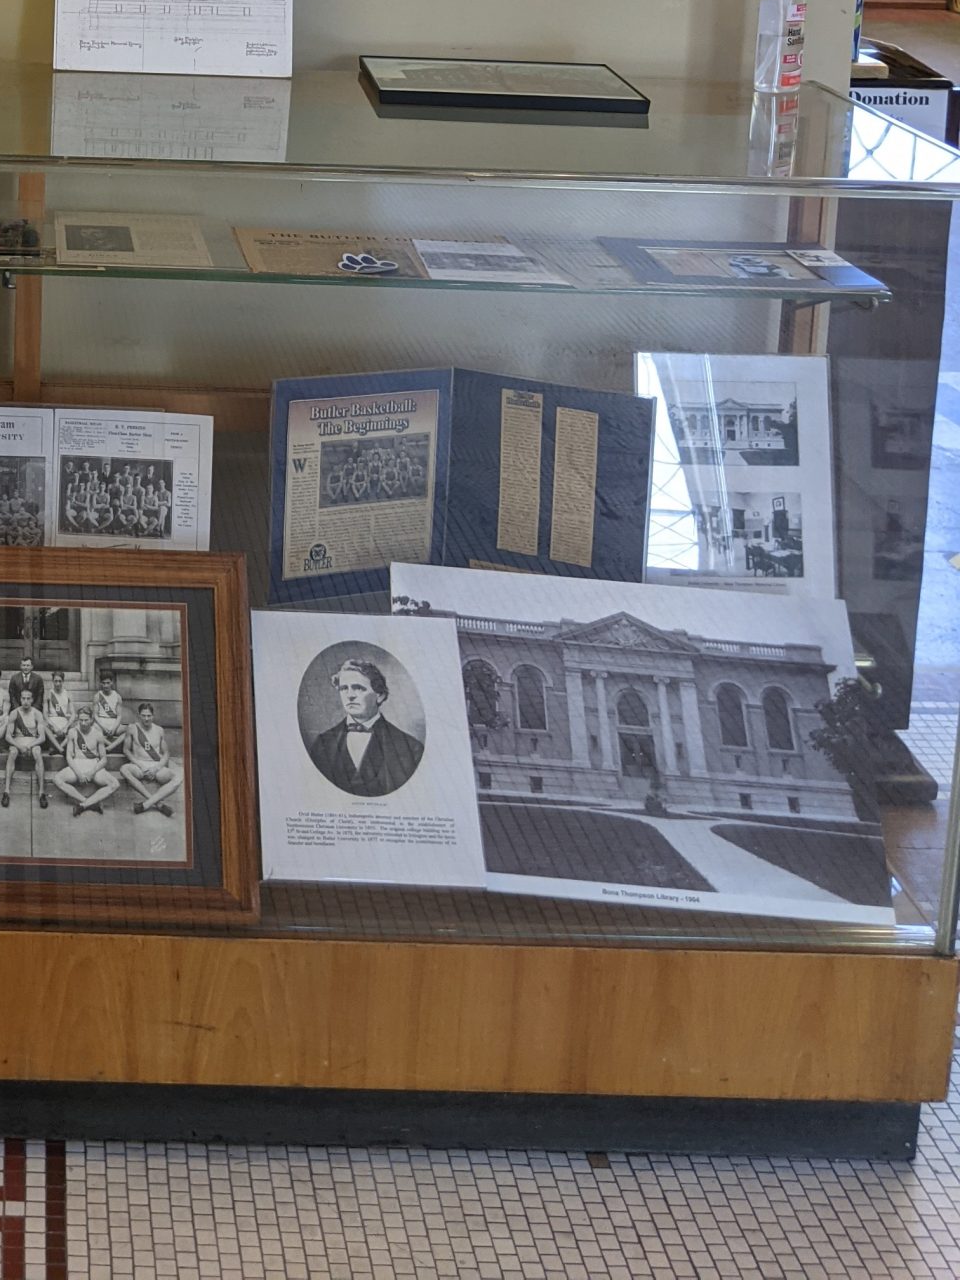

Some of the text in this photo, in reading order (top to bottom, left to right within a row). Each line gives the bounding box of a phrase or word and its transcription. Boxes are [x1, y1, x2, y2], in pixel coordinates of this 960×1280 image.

[849, 91, 929, 106] Donation
[310, 399, 417, 421] Butler Basketball:
[318, 417, 409, 436] The Beginnings
[303, 556, 333, 571] BUTLER
[620, 890, 655, 899] Thompson
[656, 893, 679, 902] Library
